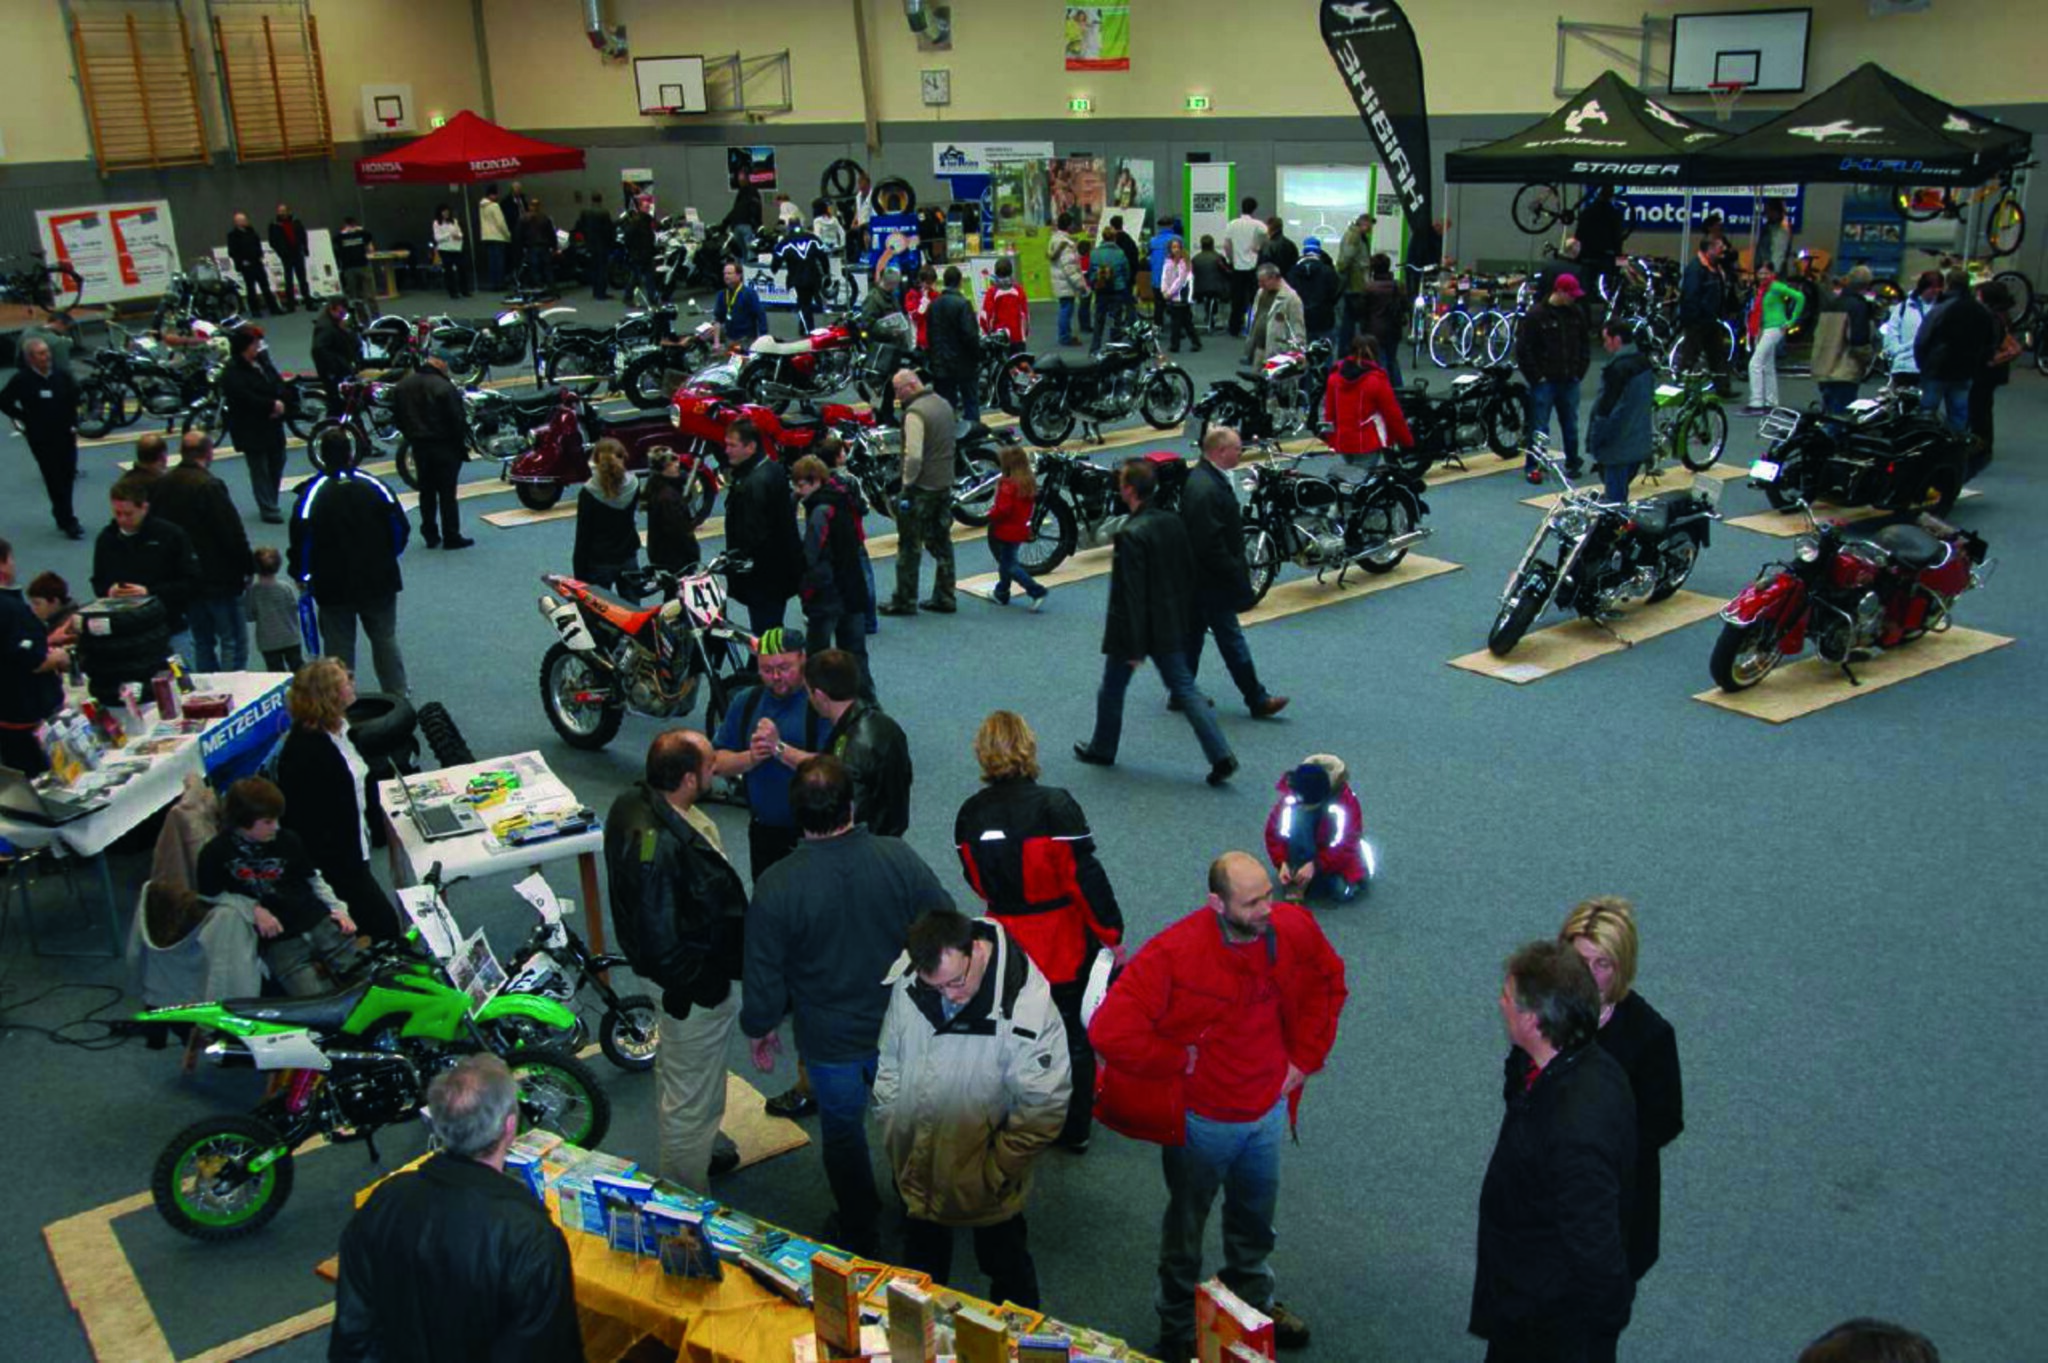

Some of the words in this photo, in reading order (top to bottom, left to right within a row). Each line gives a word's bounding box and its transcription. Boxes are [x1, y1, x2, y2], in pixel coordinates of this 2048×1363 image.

[361, 161, 402, 173] HONDA
[469, 157, 521, 171] HONDA
[692, 580, 721, 610] 41
[202, 692, 283, 757] METZELER
